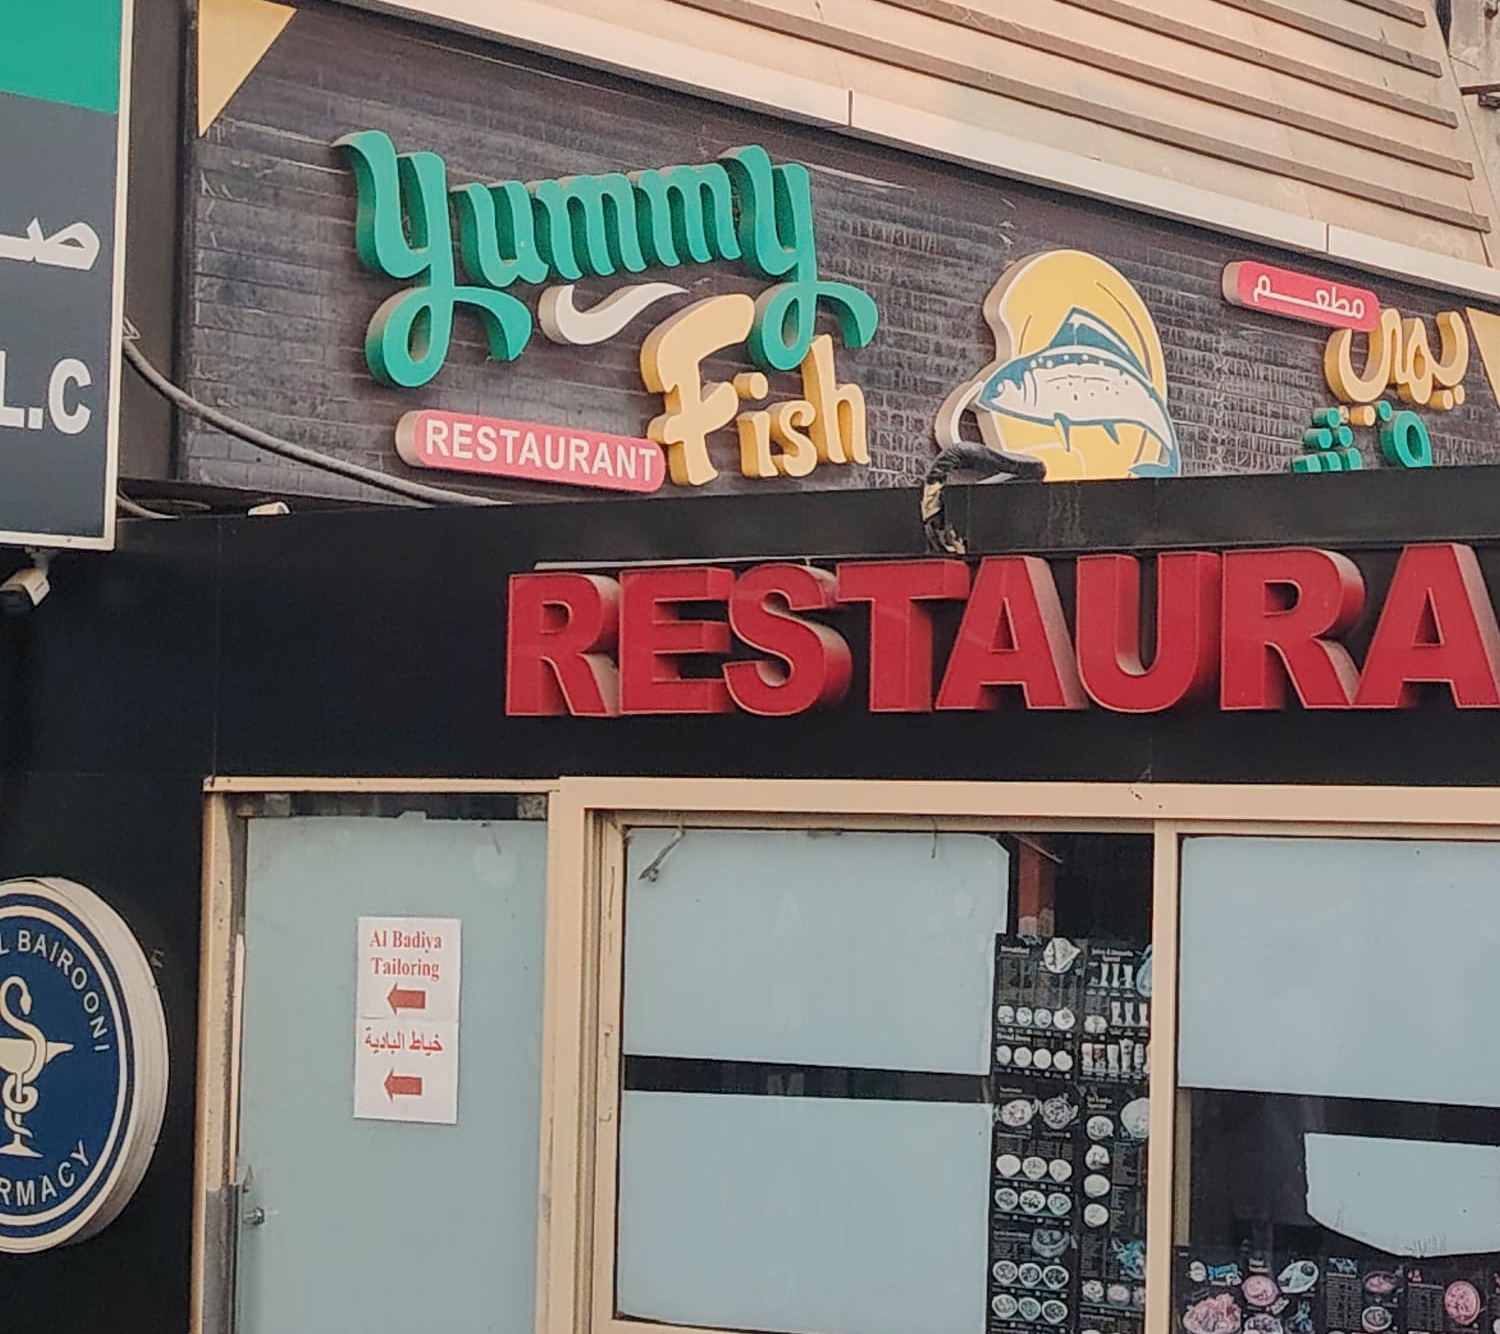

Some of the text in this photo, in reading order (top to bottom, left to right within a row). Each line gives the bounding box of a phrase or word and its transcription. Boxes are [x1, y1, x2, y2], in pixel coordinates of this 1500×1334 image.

[1253, 274, 1366, 320] مطعم
[640, 294, 870, 486] Fish
[425, 419, 659, 484] RESTAURANT
[370, 931, 442, 953] Al Badiya
[18, 930, 110, 1051] BAIROONI
[371, 957, 440, 980] Tailoring
[408, 1030, 443, 1056] خياط
